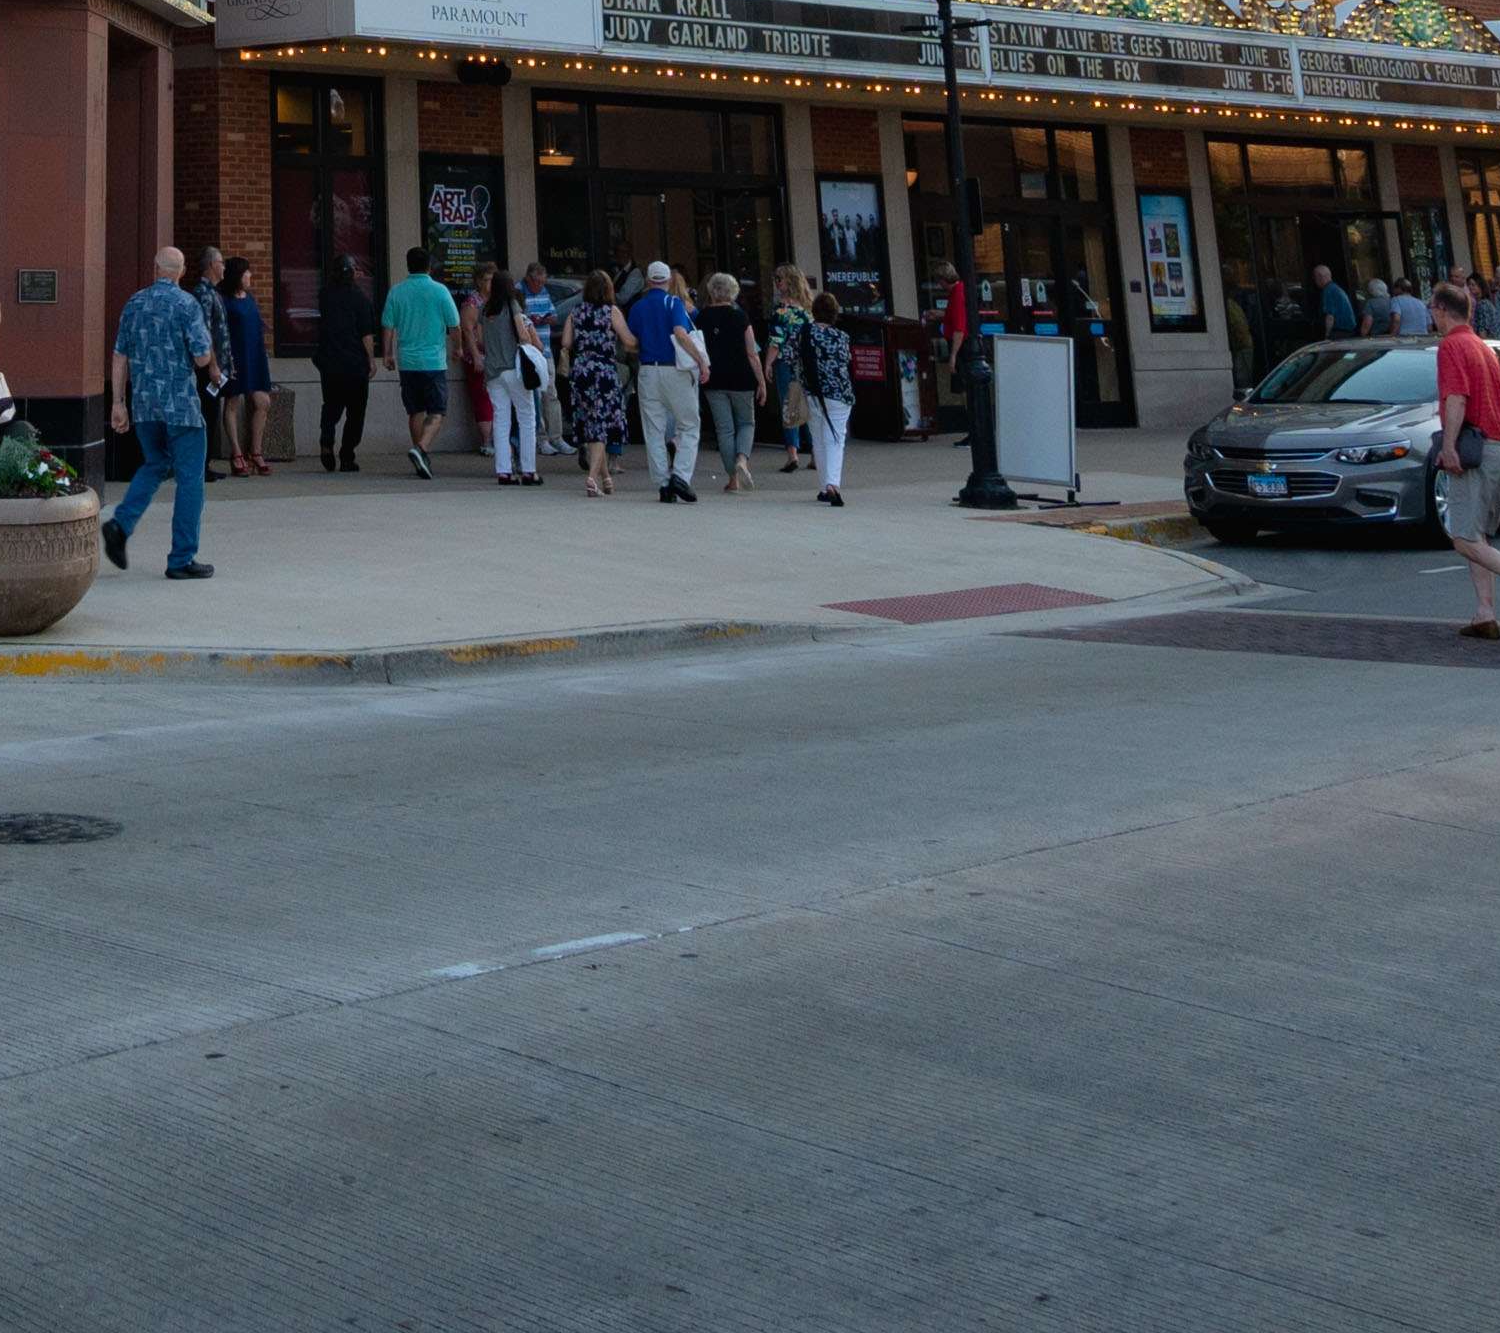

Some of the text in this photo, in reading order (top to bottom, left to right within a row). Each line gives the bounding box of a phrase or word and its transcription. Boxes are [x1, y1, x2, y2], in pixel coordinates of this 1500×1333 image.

[431, 4, 529, 28] PARAMOUNT
[603, 17, 832, 58] JUDY GARLAND TRIBUTE
[990, 22, 1290, 68] STAYIN' ALIVE BEE GEES TRIBUTE JUNE 15
[918, 42, 981, 69] JUN 10
[991, 49, 1141, 82] BLUES ON THE FOX
[1300, 50, 1347, 74] GEORGE
[1351, 54, 1420, 81] THOROGOOD
[1423, 62, 1433, 82] &
[1436, 62, 1478, 86] FOGHAT
[1222, 69, 1294, 94] JUNE 15-16
[1304, 77, 1381, 101] ONEREPUBLIC
[431, 189, 466, 208] ART
[441, 206, 475, 223] RAP
